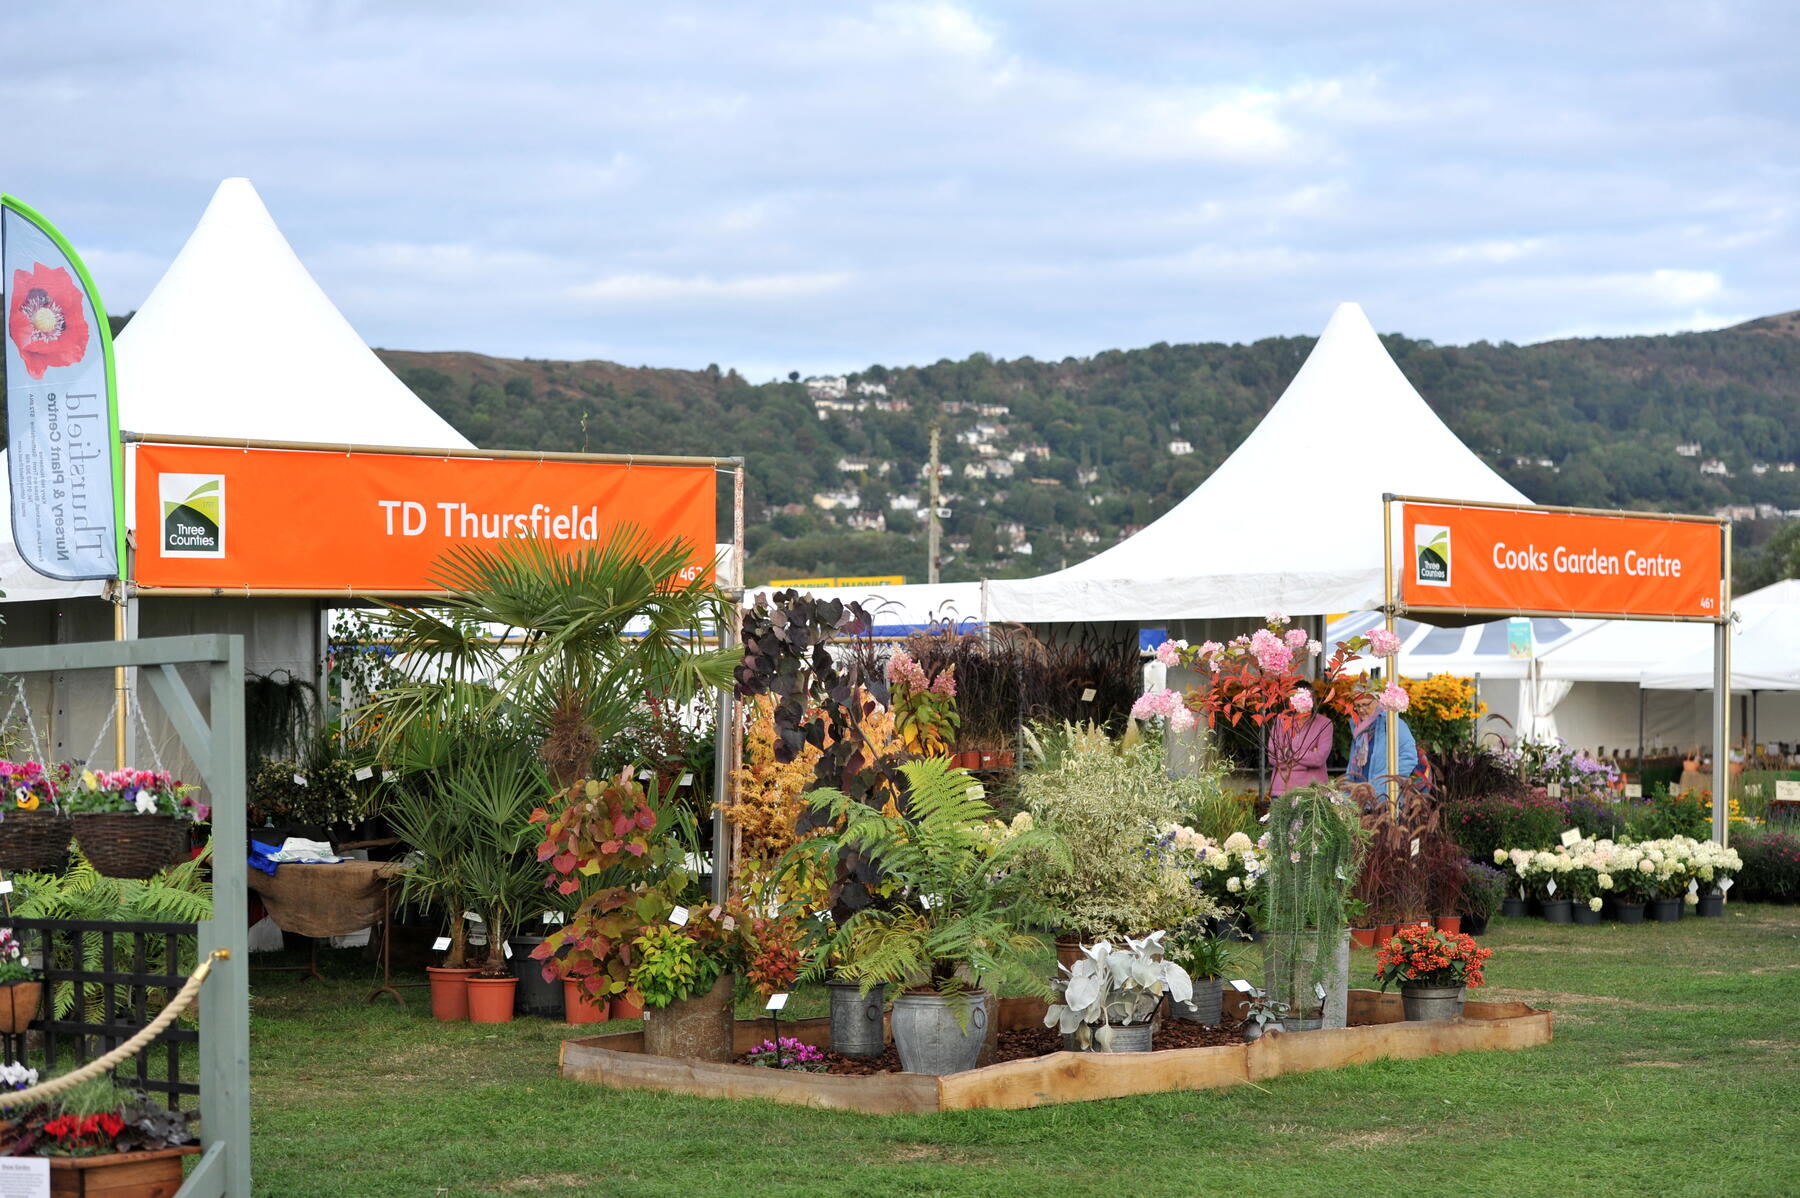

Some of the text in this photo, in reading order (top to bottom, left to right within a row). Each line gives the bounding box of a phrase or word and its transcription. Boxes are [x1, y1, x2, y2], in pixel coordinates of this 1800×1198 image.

[378, 500, 599, 541] TD Thursfield
[177, 524, 205, 535] Three
[169, 534, 214, 546] Counties
[1424, 561, 1440, 569] Three
[1492, 542, 1681, 578] Cooks Garden Centre
[1421, 568, 1445, 578] Counties
[1700, 597, 1714, 609] 461
